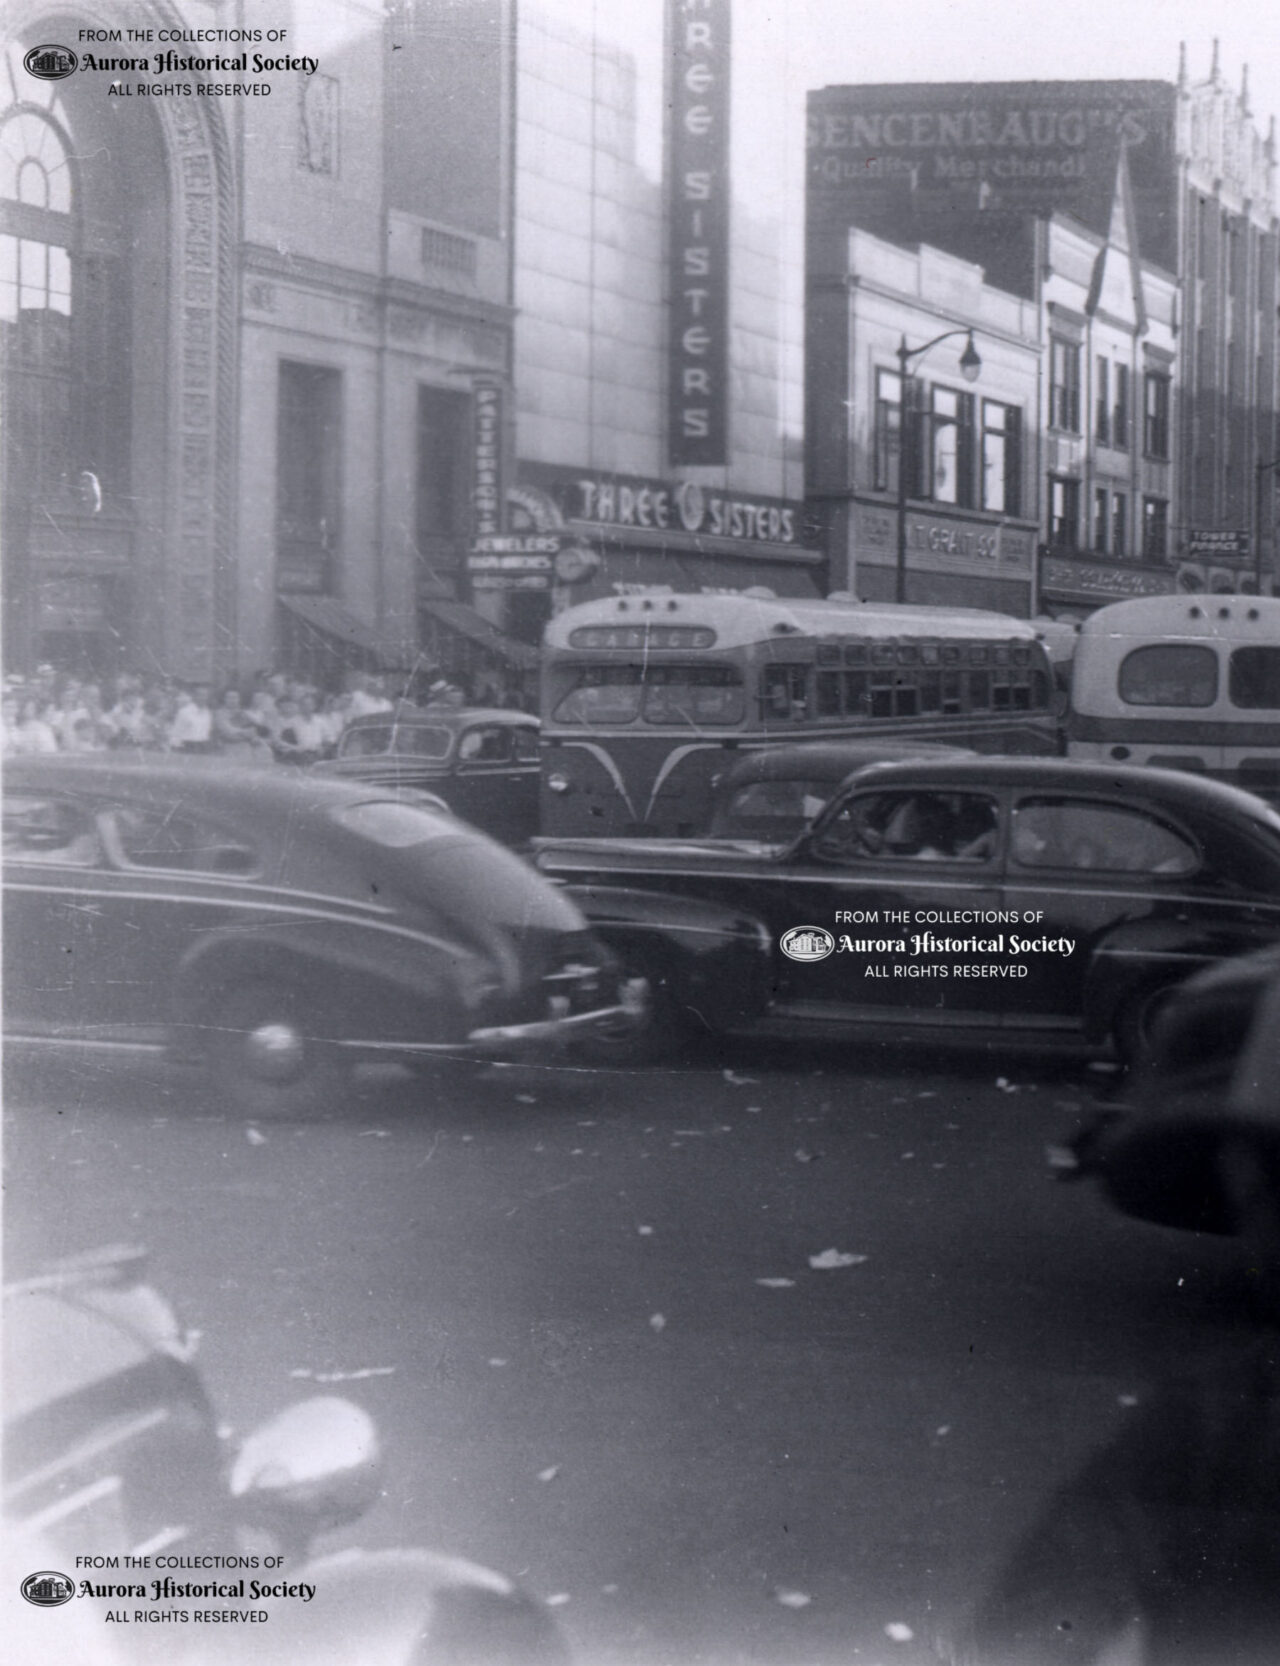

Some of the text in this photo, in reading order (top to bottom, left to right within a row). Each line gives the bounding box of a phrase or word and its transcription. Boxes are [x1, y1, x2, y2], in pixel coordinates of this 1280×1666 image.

[682, 0, 714, 437] REE SISTERS
[579, 480, 668, 528] THREE
[711, 499, 794, 542] SISTERS
[473, 537, 561, 553] JEWELERS
[586, 632, 707, 647] GARAGE
